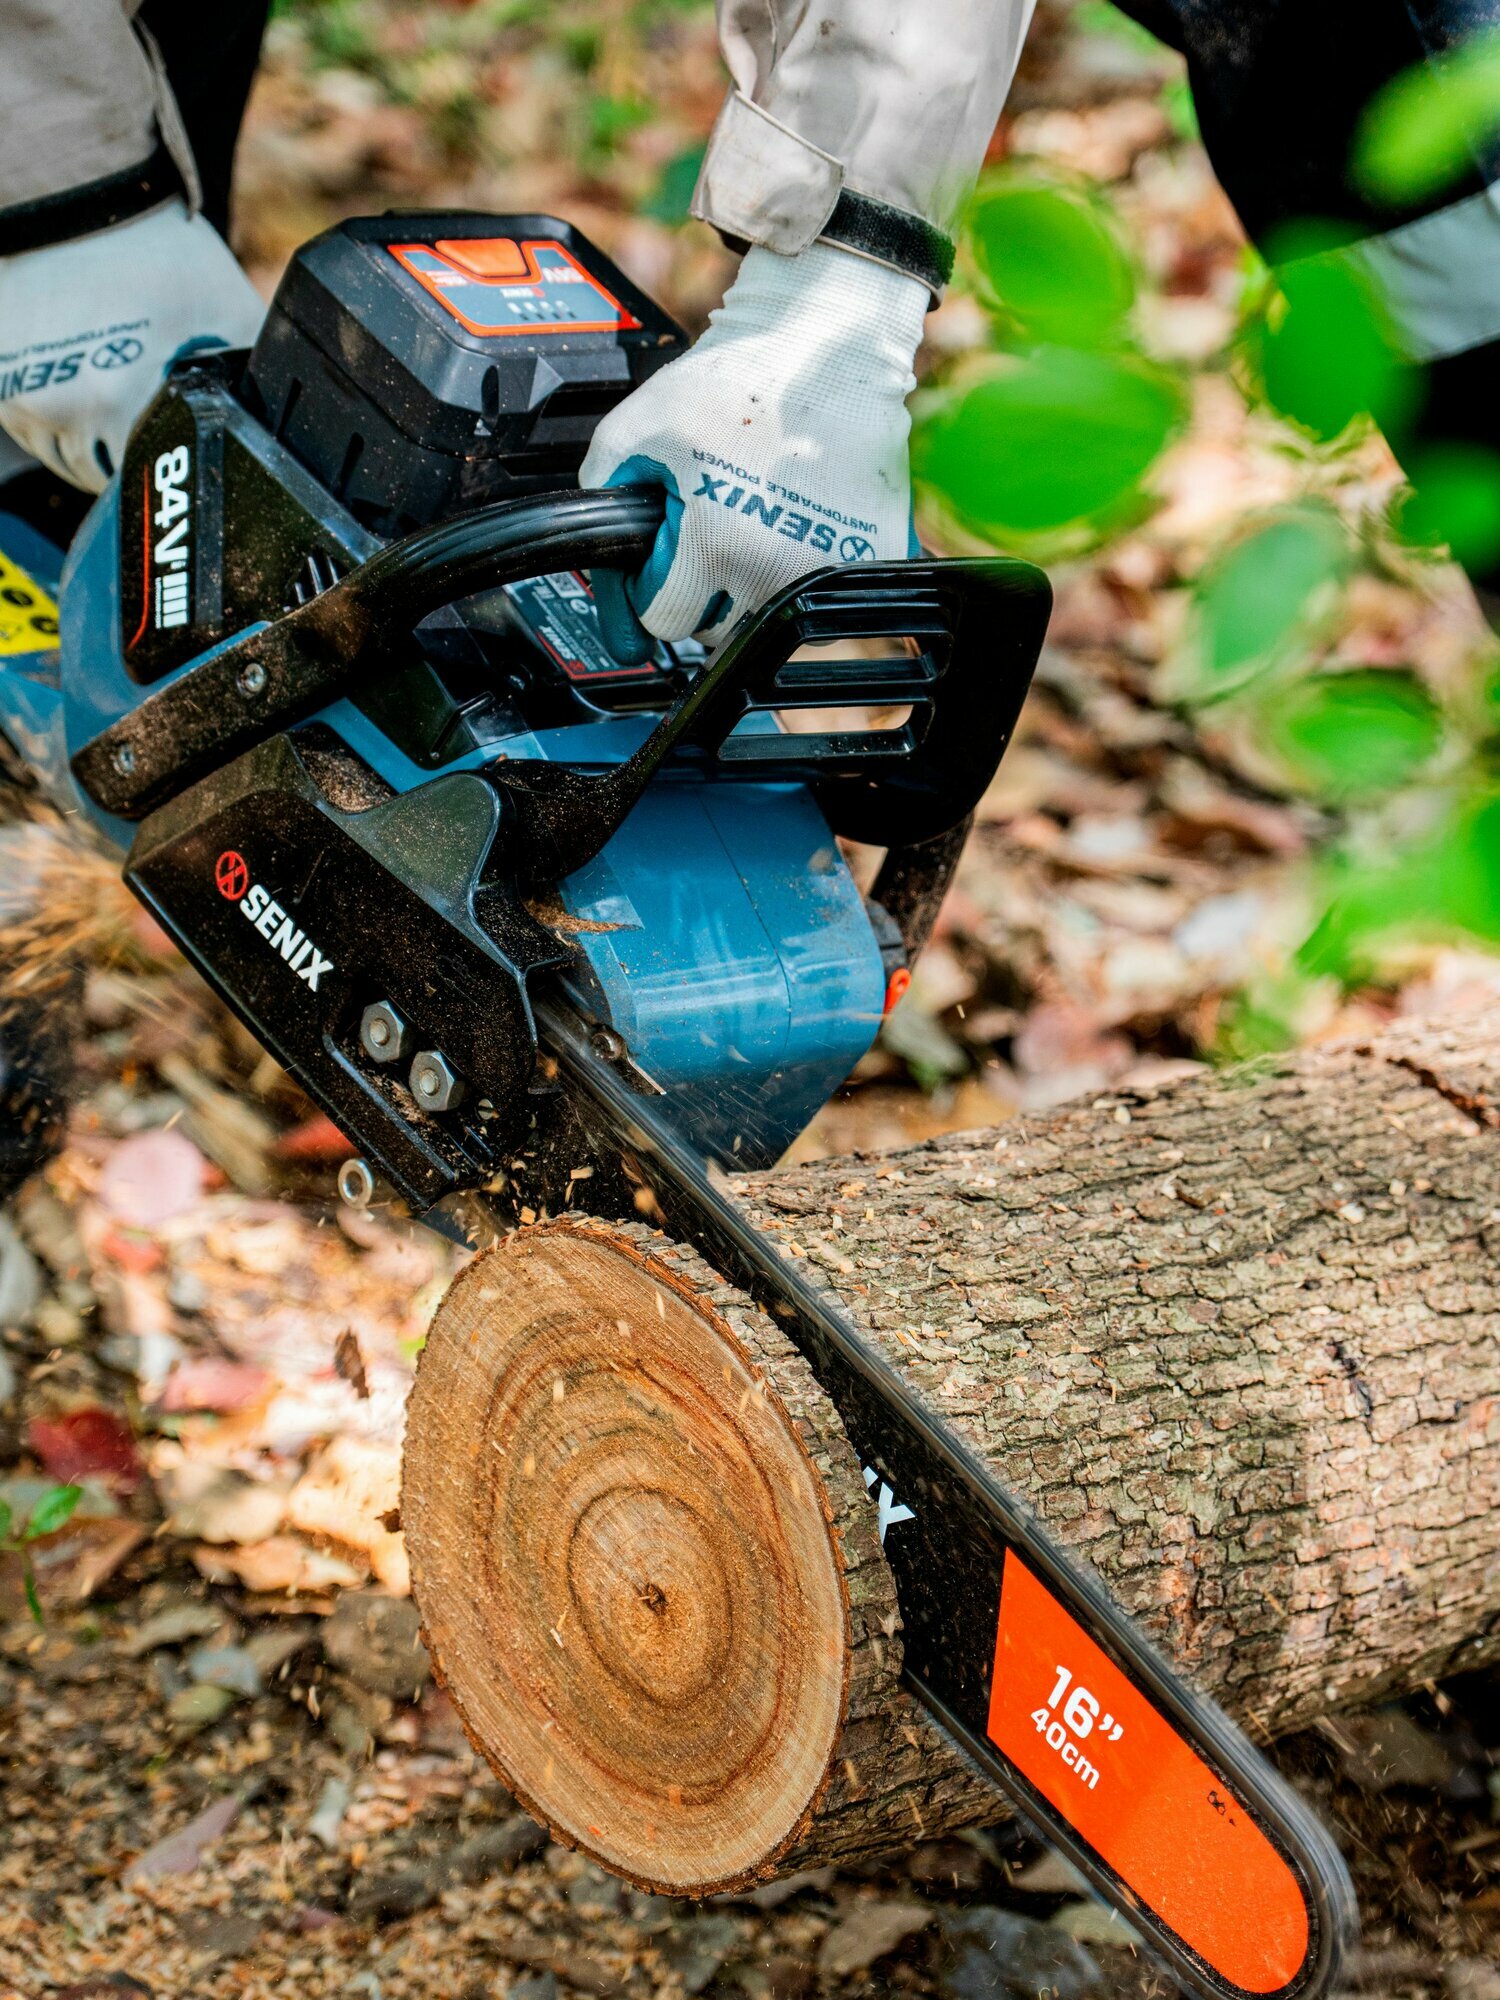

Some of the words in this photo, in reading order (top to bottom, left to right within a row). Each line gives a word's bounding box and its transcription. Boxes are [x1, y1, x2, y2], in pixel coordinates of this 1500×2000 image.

[0, 352, 85, 400] SENI
[155, 445, 189, 563] 84V
[693, 449, 761, 484] POWER
[693, 472, 837, 553] SENIX
[766, 481, 878, 535] UNSTOPPABLE
[240, 884, 334, 992] SENIX
[1030, 1708, 1100, 1790] 40cm
